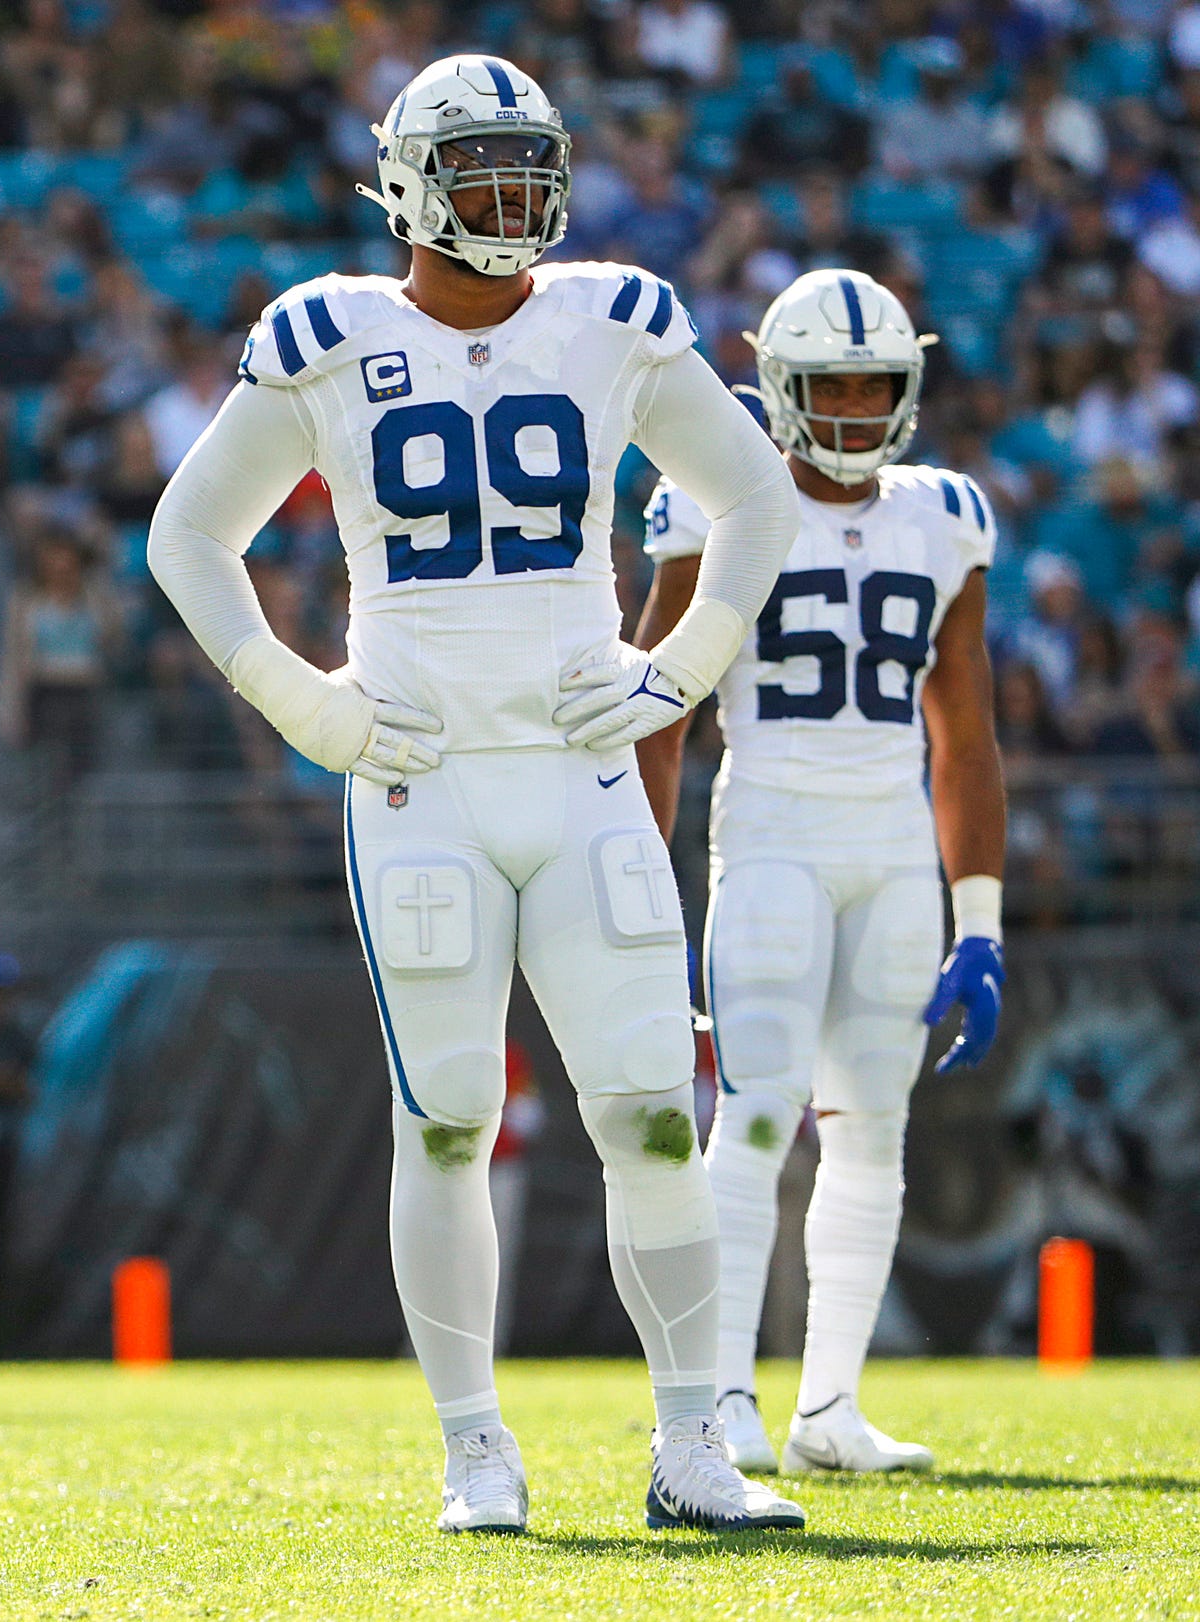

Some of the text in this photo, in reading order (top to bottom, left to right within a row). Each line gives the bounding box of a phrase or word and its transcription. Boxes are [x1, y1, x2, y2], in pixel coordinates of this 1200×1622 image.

[495, 110, 529, 120] COLTS
[365, 355, 407, 390] C
[371, 394, 589, 583] 99
[757, 568, 935, 725] 58
